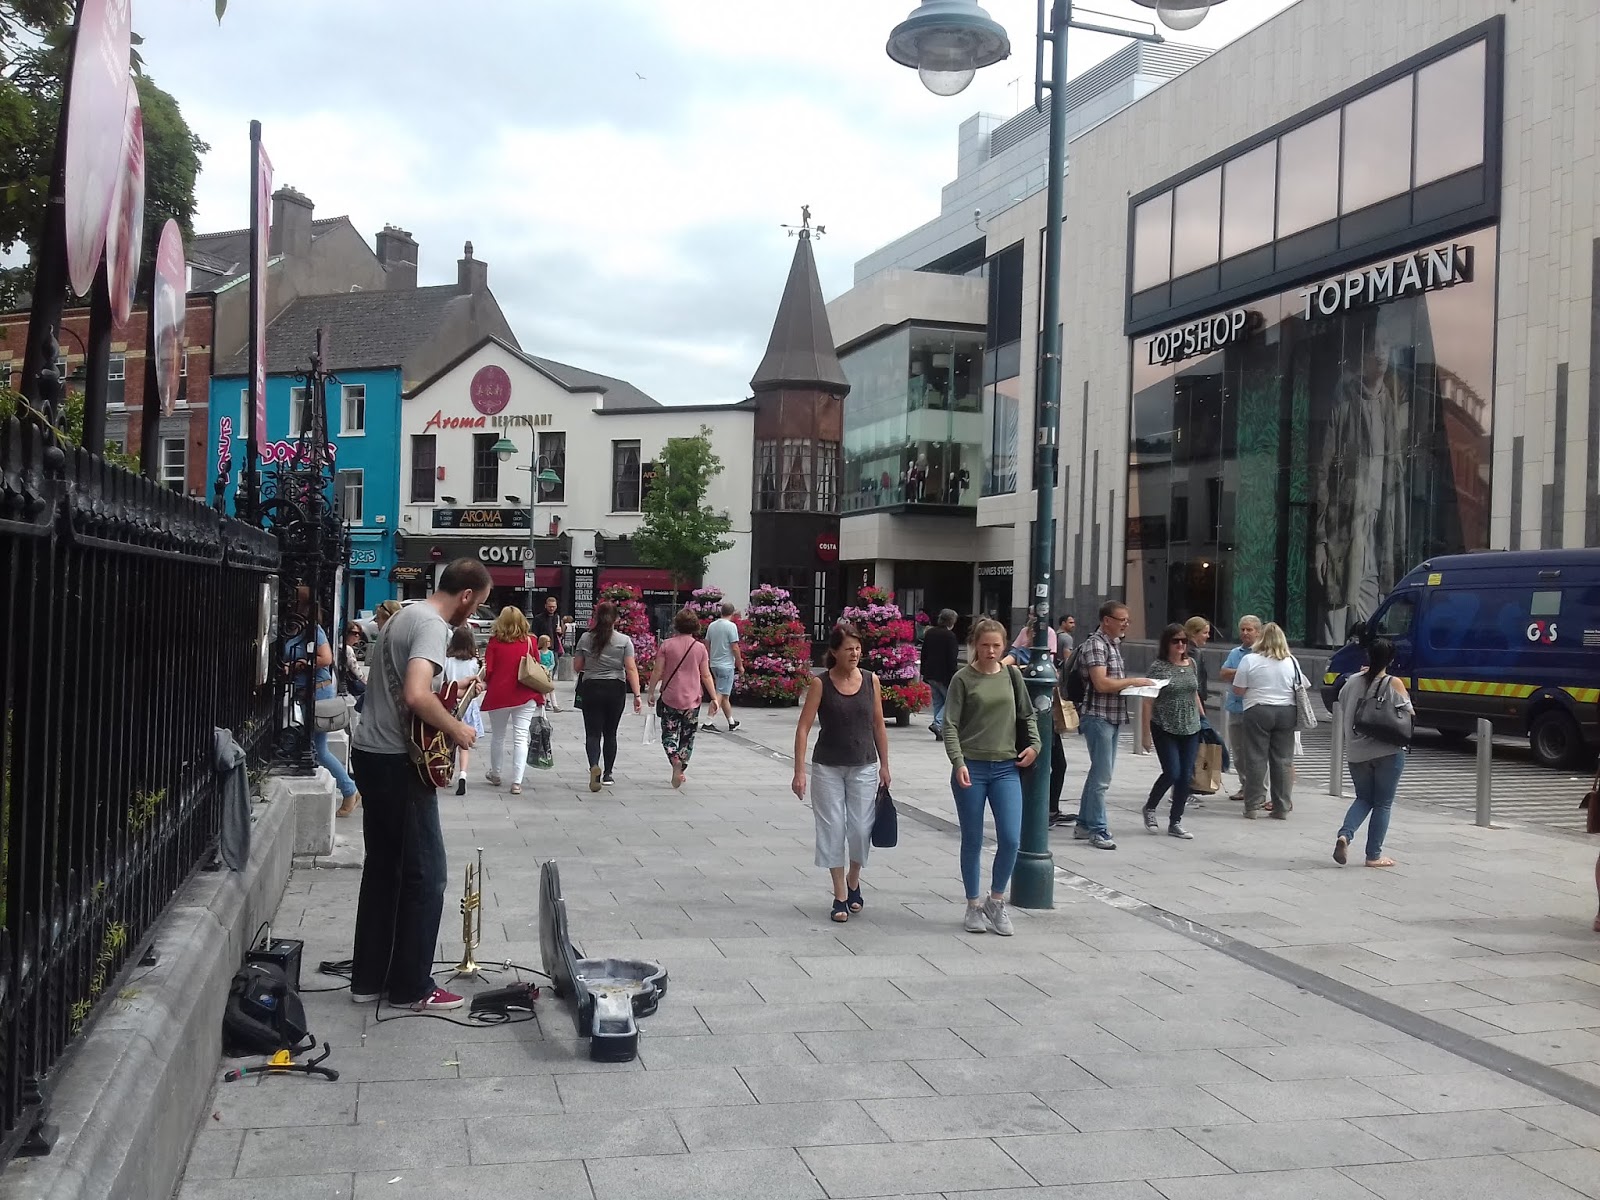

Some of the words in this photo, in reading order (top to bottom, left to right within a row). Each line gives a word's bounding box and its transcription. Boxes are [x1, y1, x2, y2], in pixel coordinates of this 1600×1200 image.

[1300, 243, 1460, 321] TOPMAN
[1145, 308, 1247, 364] TOPSHOP
[423, 409, 487, 433] Aroma
[491, 413, 553, 428] RESTAURANT
[217, 416, 233, 484] ONUTS
[261, 440, 338, 467] DONUS
[460, 509, 502, 523] AROMA
[349, 548, 377, 566] gers
[819, 542, 837, 551] COSTA
[392, 566, 422, 574] AROMA
[997, 566, 1014, 576] STORE
